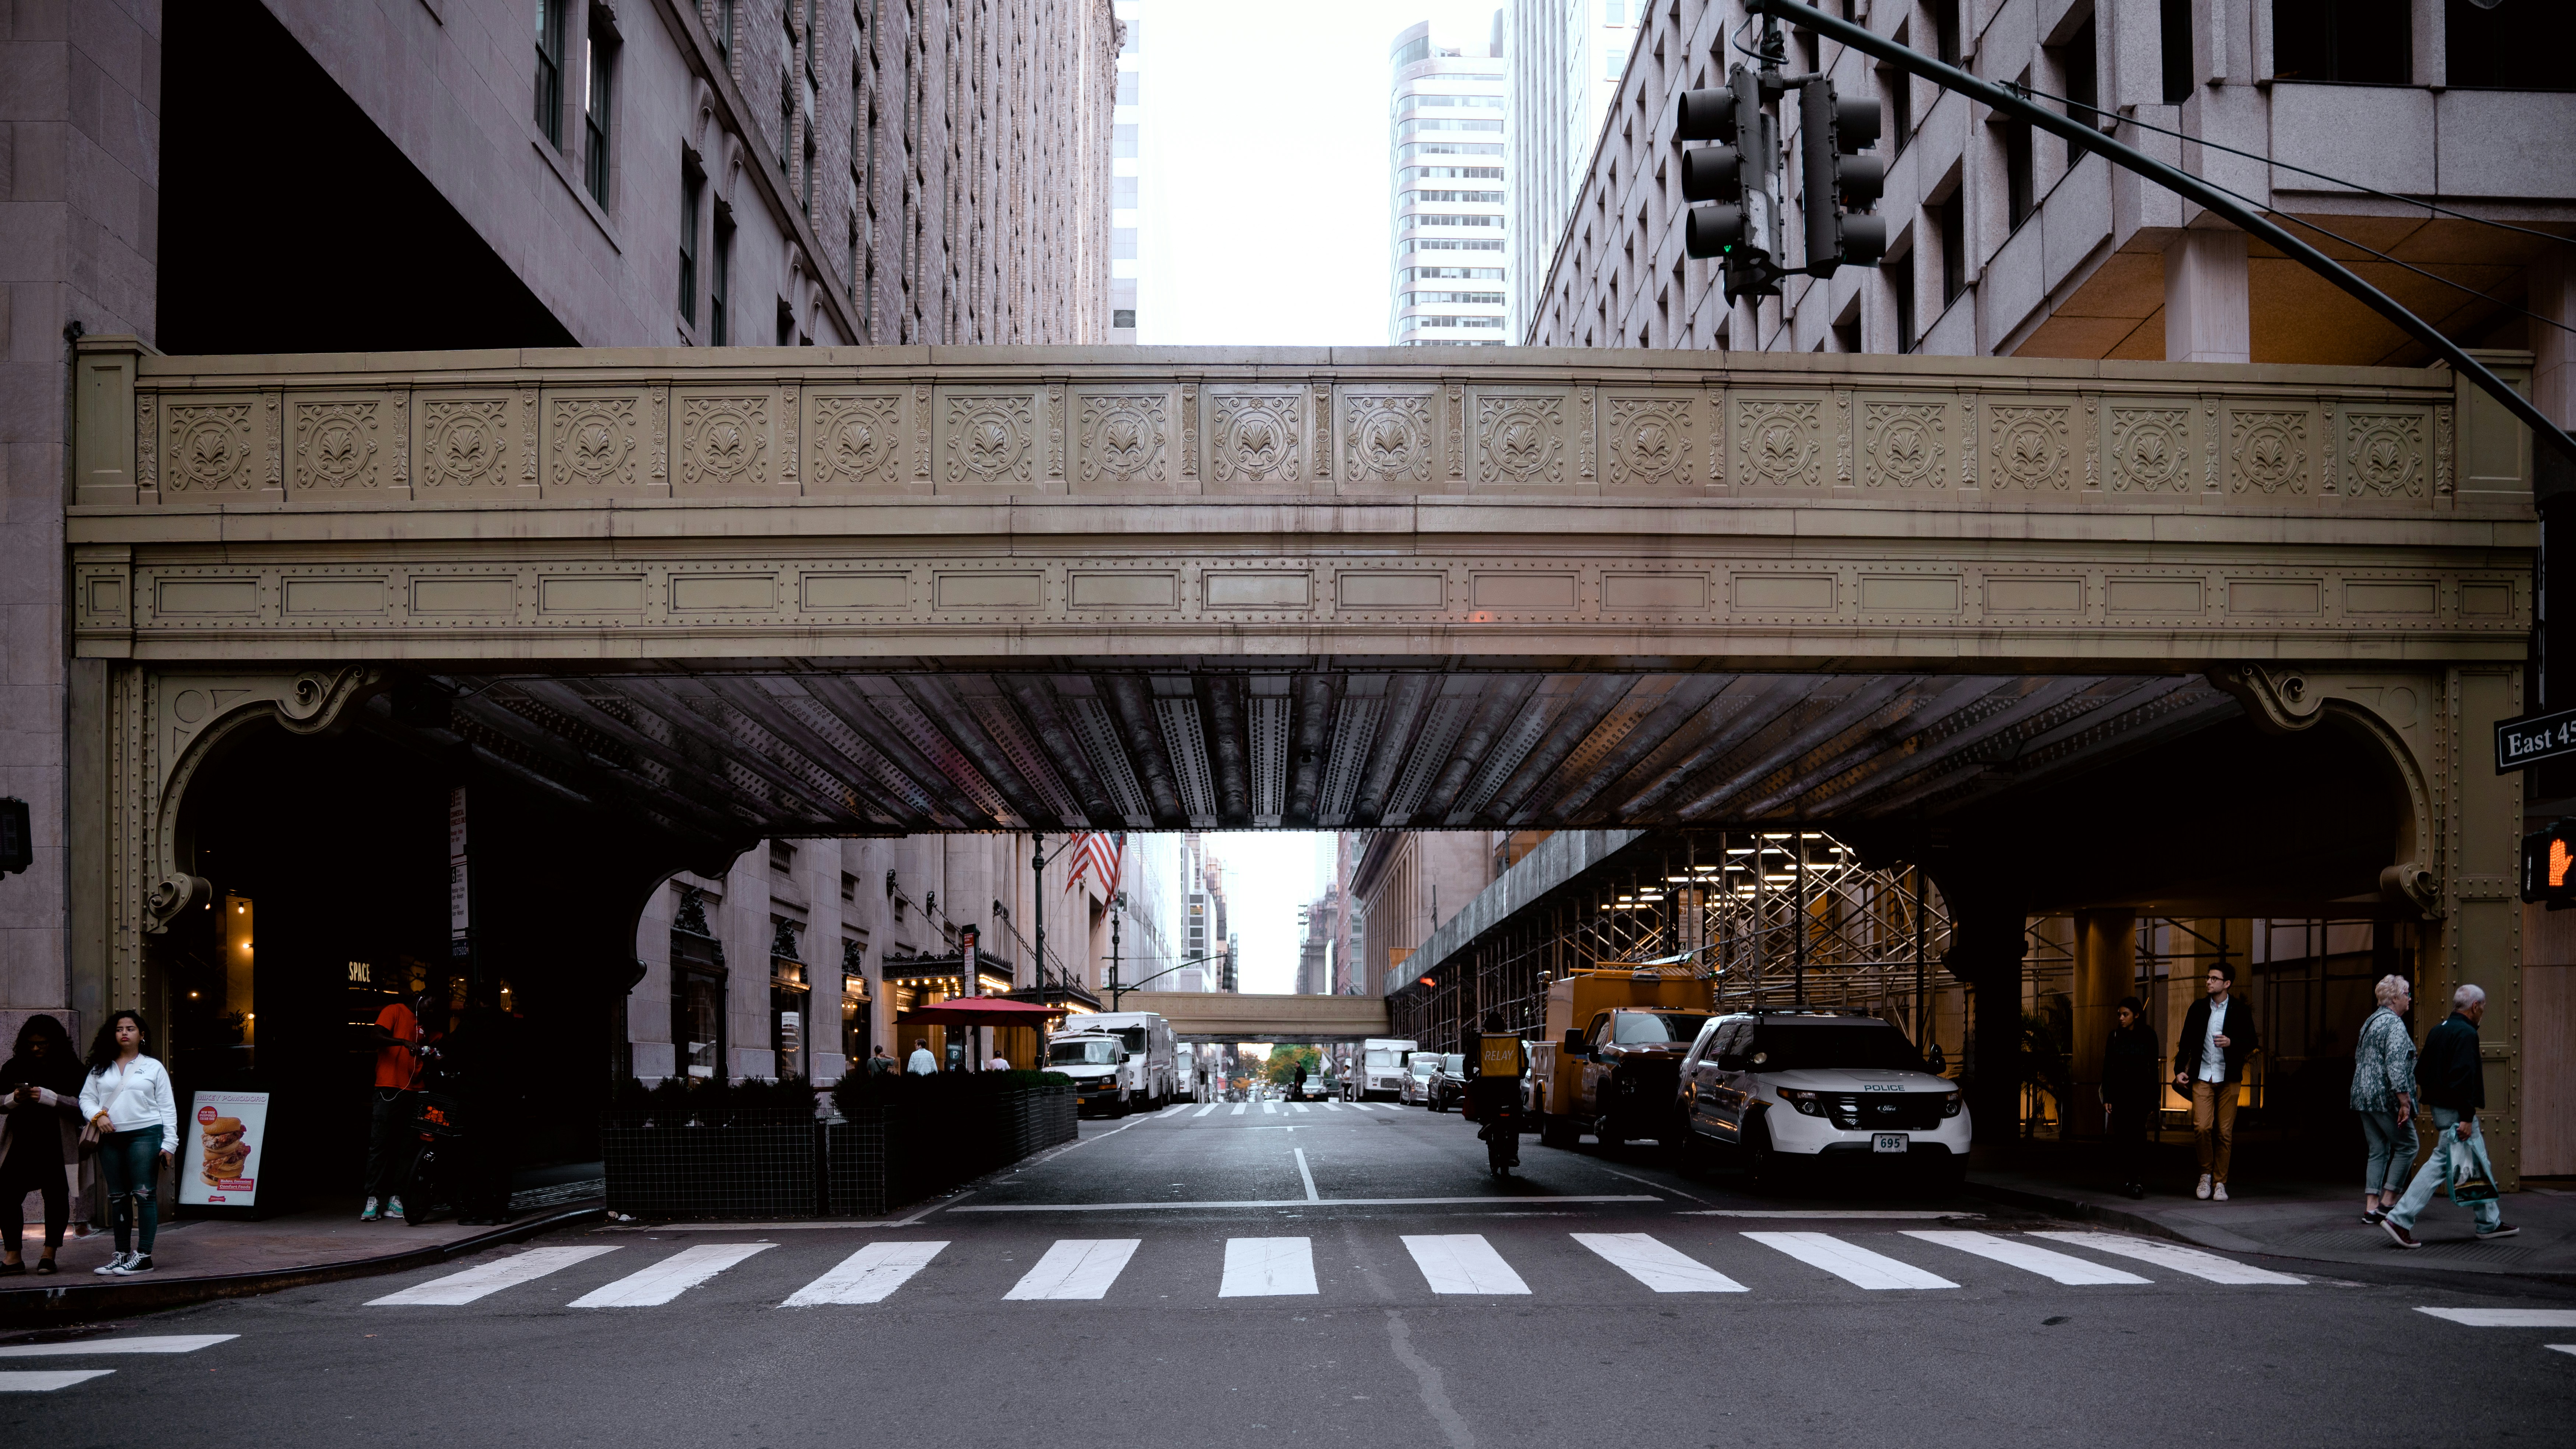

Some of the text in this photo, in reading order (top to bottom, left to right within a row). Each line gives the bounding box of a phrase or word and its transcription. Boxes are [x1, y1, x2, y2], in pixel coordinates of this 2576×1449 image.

[2508, 729, 2552, 757] East
[451, 792, 454, 806] 3
[451, 809, 464, 818] COMMERCIAL
[451, 818, 461, 826] VEHICLES
[452, 869, 455, 882] 6
[349, 961, 371, 983] SPACE
[1485, 1050, 1514, 1061] RELAY
[1881, 1138, 1900, 1148] 695
